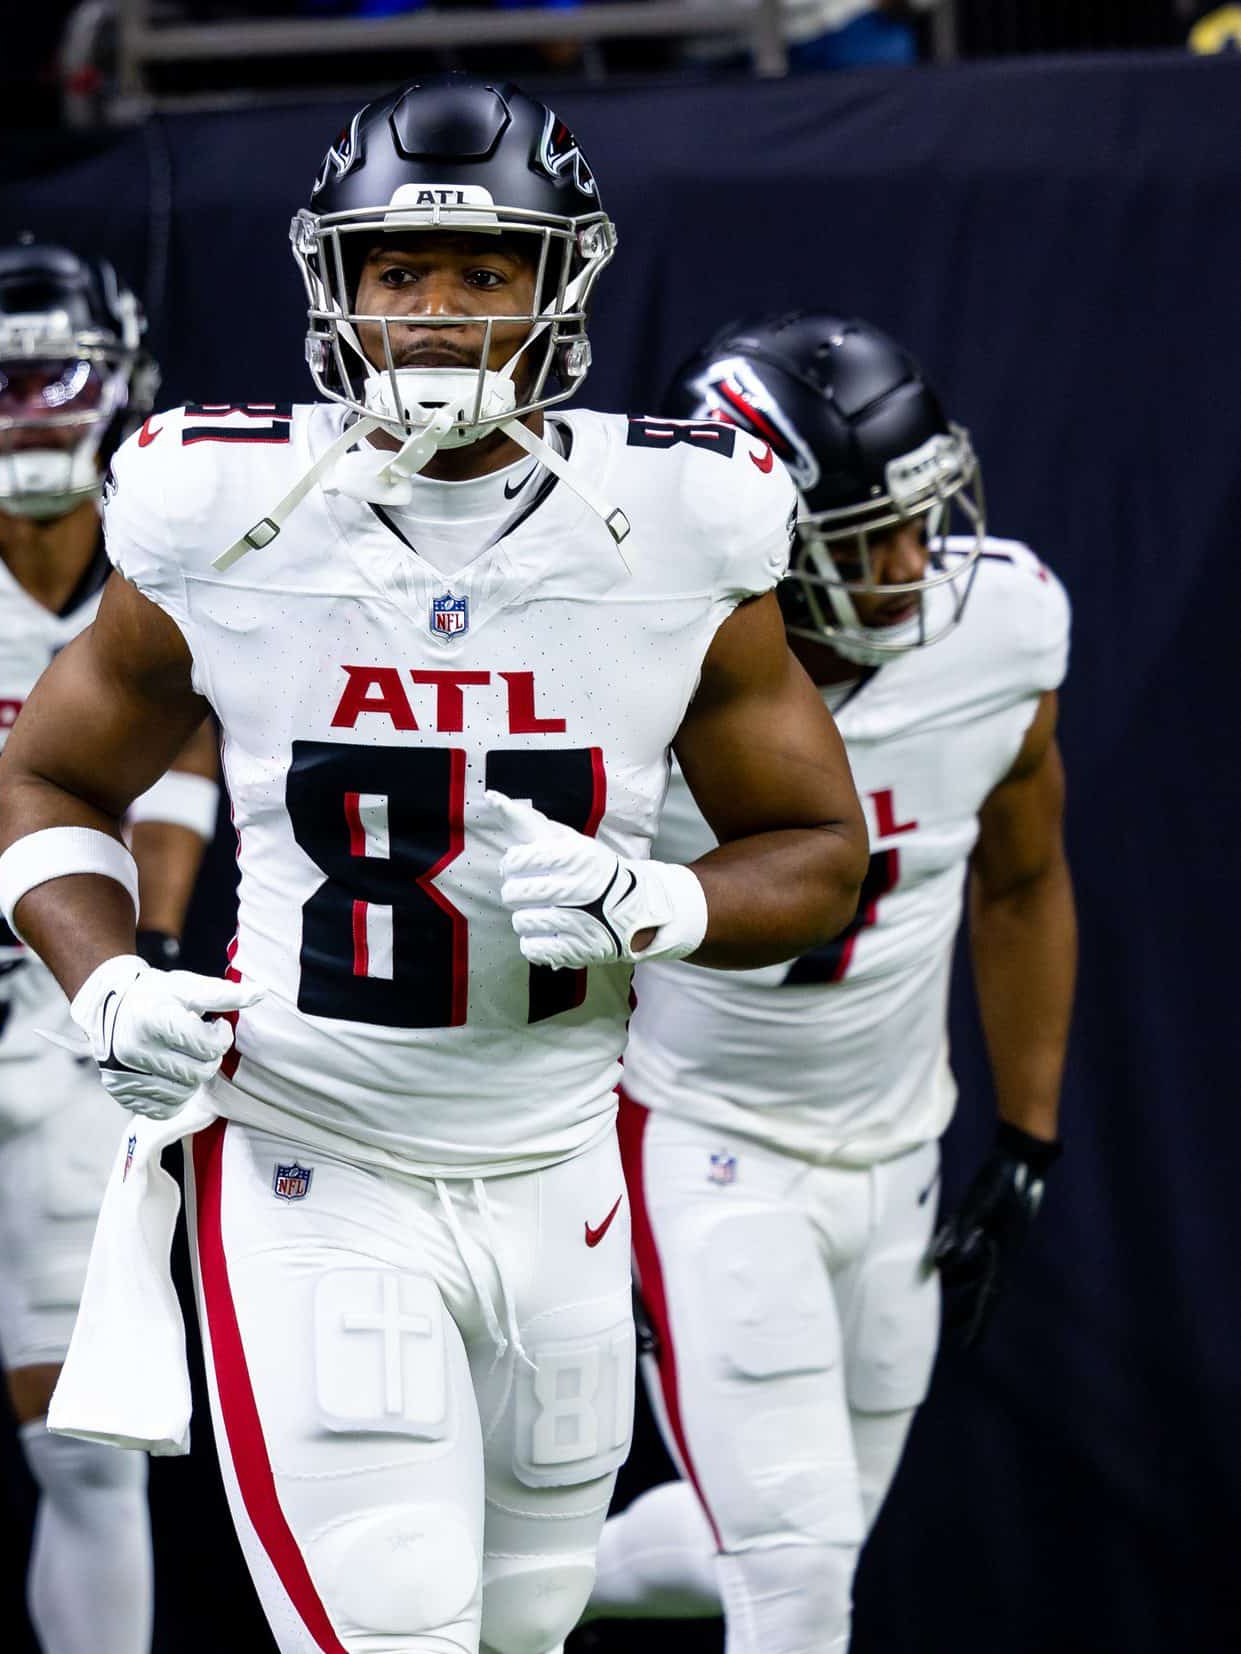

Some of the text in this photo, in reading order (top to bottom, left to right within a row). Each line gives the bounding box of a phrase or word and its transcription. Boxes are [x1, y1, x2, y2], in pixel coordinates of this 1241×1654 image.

[416, 191, 470, 205] ATL
[436, 613, 464, 632] NFL
[330, 665, 567, 734] ATL
[278, 1178, 306, 1195] NFL
